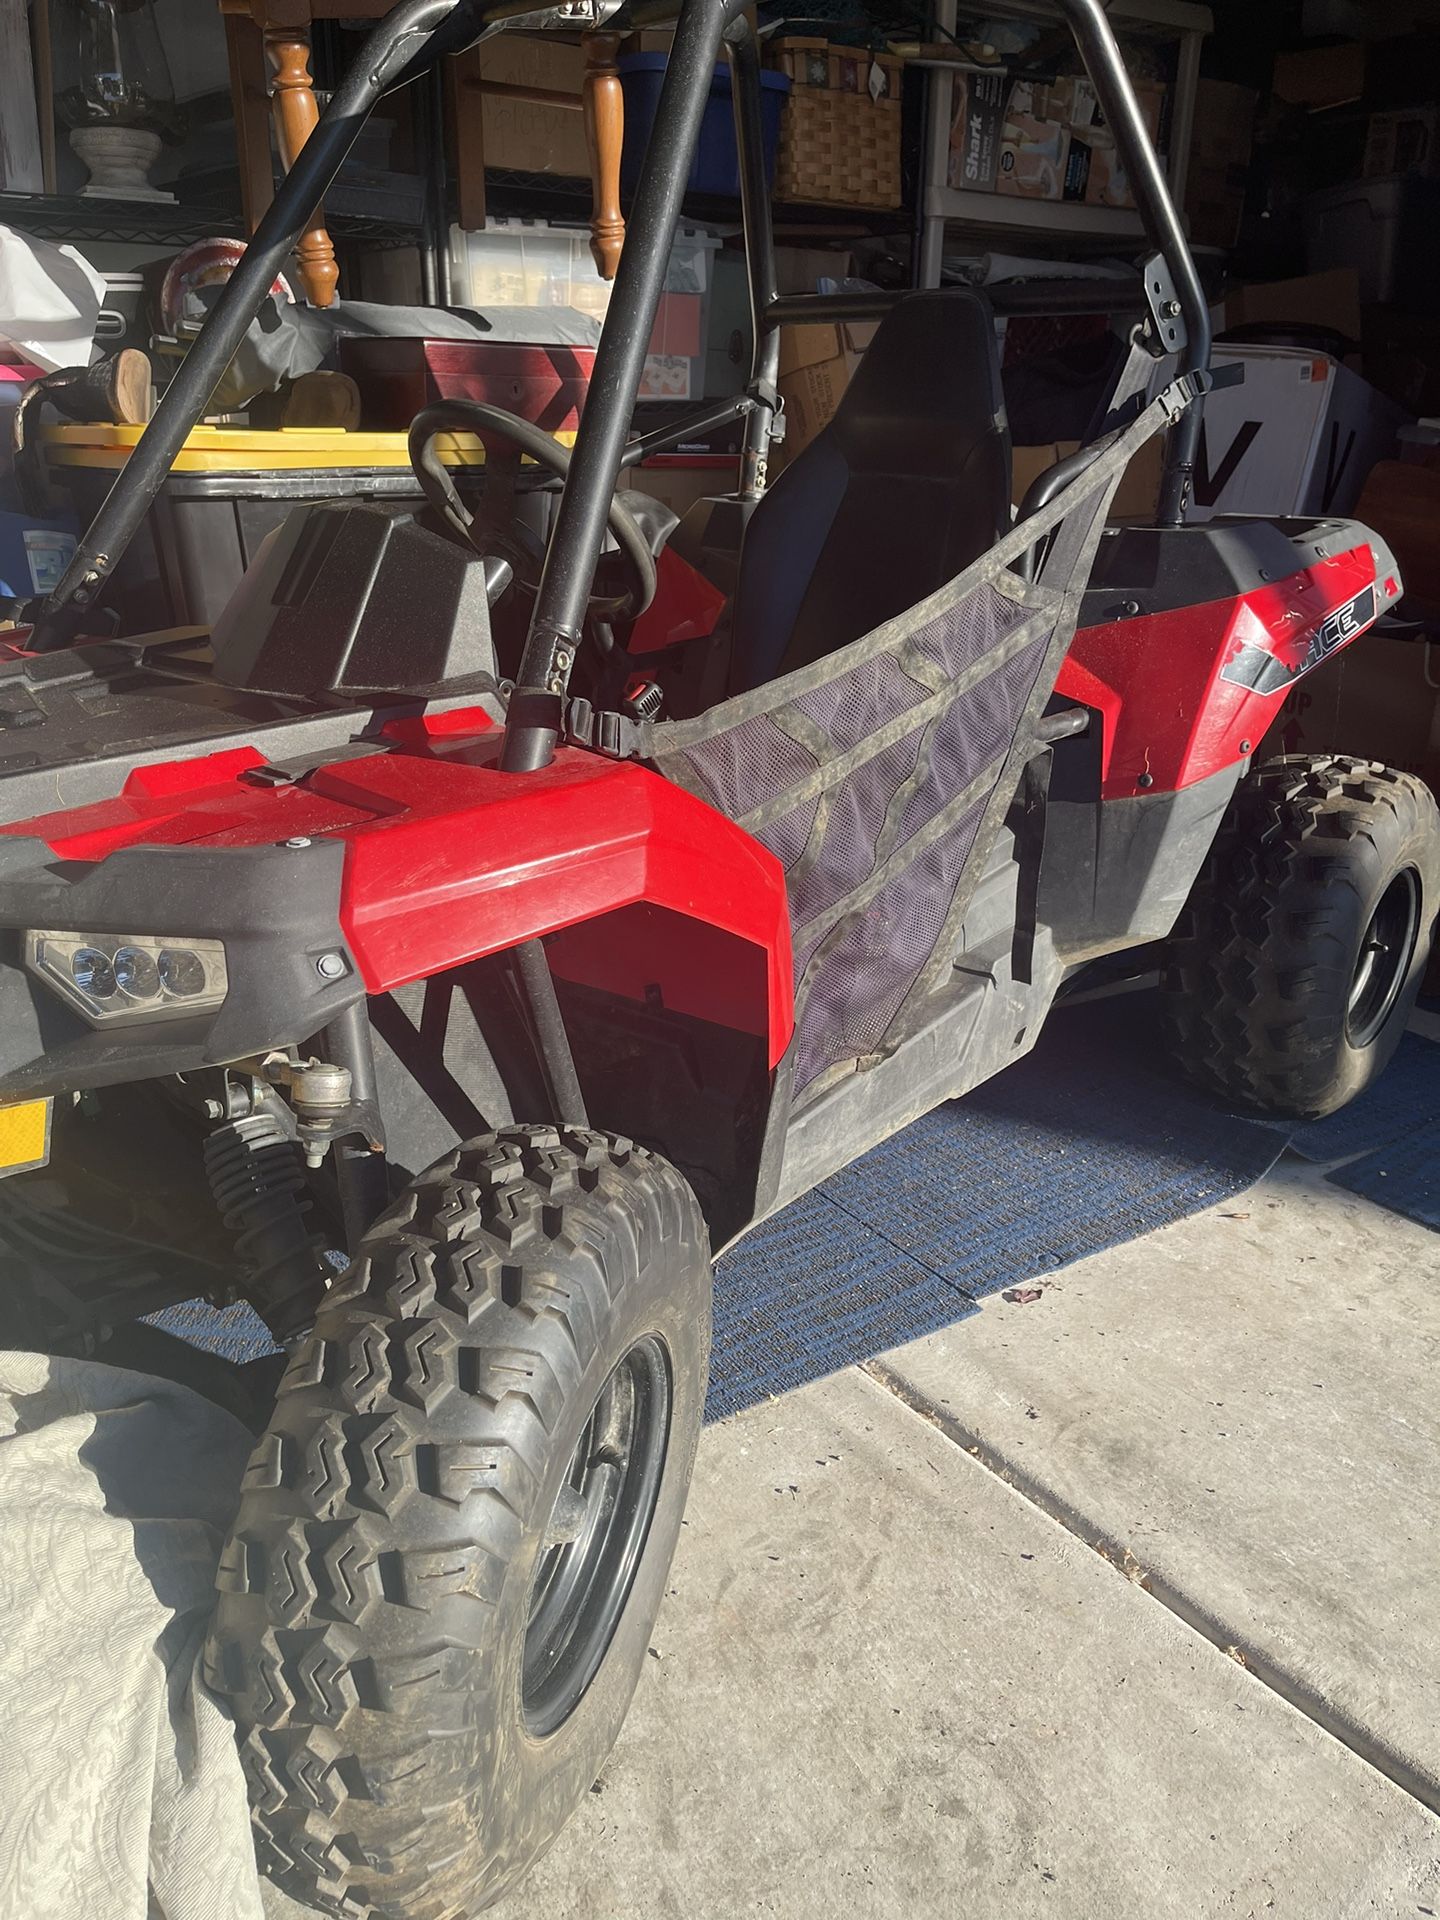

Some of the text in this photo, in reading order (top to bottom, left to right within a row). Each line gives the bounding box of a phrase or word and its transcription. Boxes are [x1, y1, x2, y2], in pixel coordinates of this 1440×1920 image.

[965, 113, 983, 180] Shark
[1321, 421, 1356, 513] V
[1299, 601, 1360, 671] ACE
